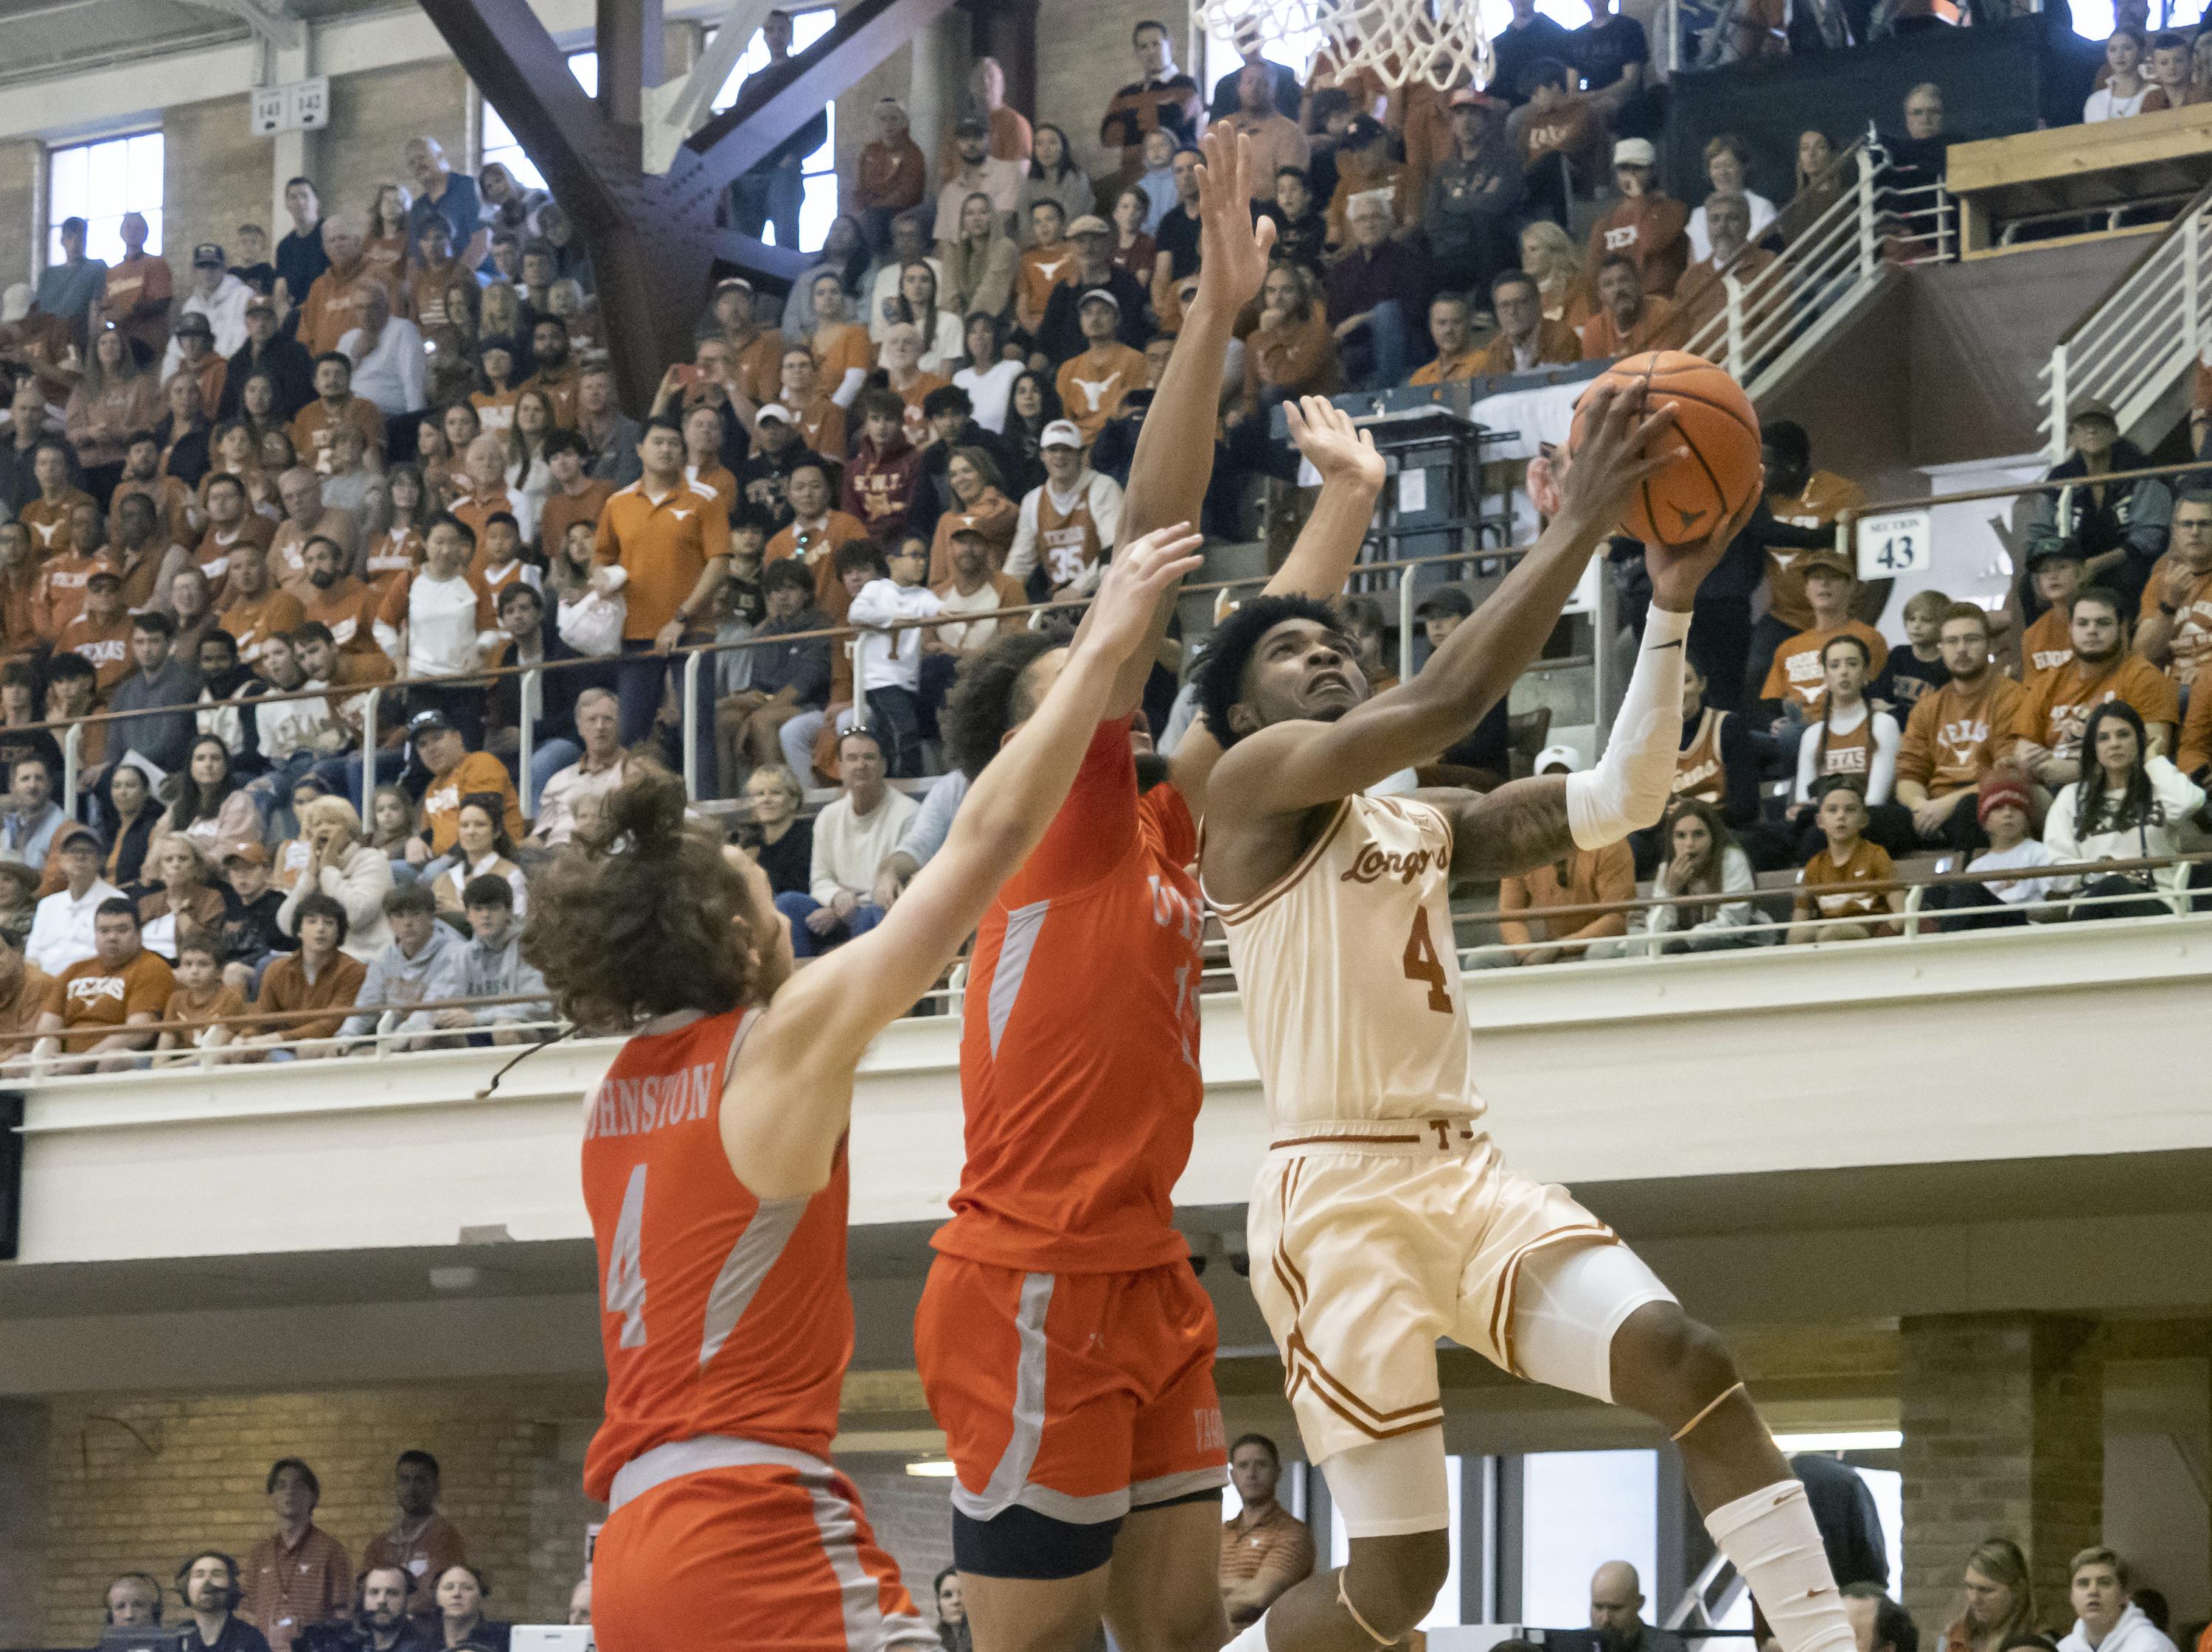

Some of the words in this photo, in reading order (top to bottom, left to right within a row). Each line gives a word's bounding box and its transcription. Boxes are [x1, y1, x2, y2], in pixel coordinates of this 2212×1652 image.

[1870, 519, 1919, 532] SECTION
[1049, 544, 1087, 583] 35
[1877, 535, 1914, 568] 43
[1402, 905, 1454, 1014] 4
[66, 976, 125, 1001] TEXAS
[585, 1062, 715, 1141] HNSTON
[1429, 1120, 1450, 1150] T
[606, 1164, 647, 1350] 4
